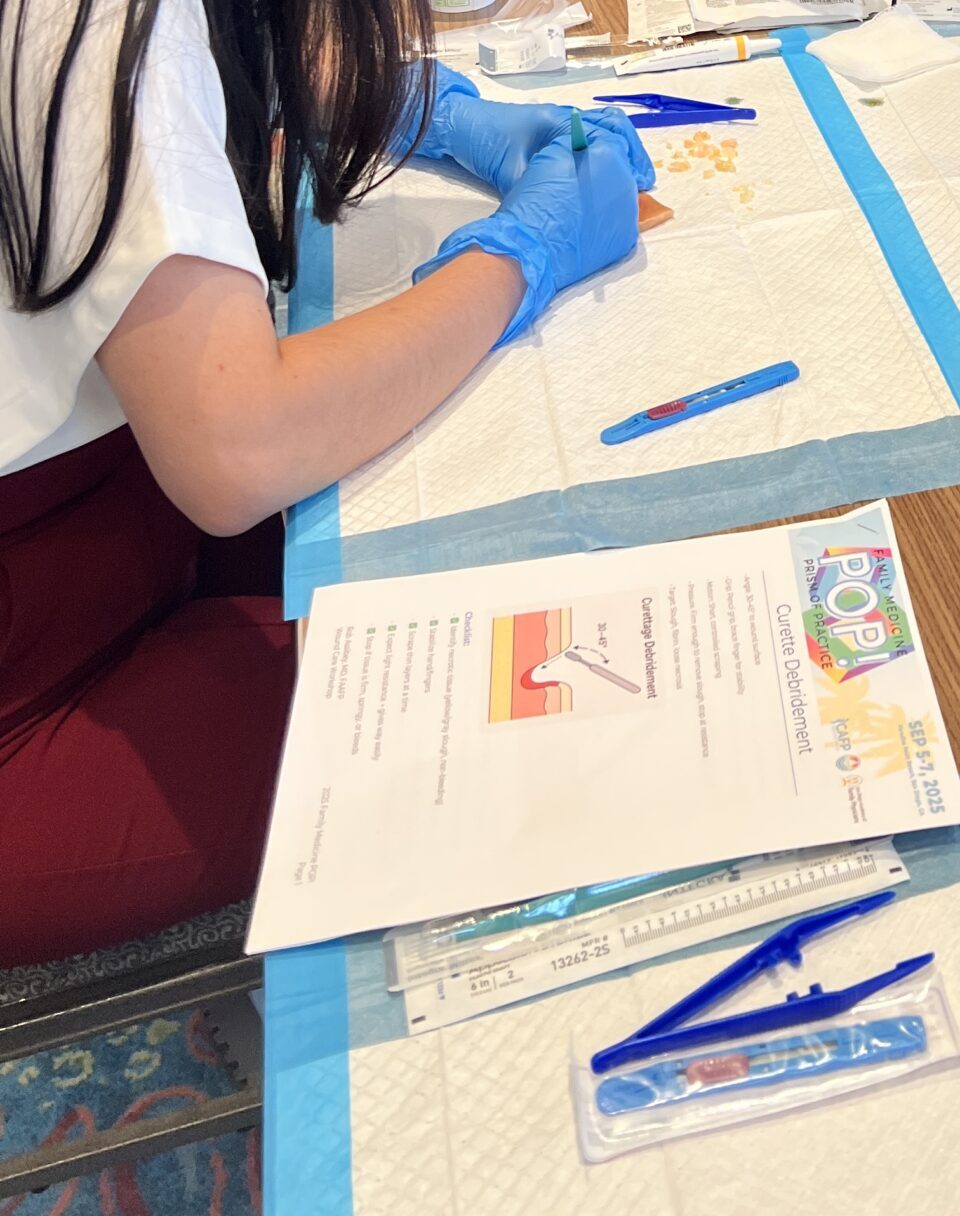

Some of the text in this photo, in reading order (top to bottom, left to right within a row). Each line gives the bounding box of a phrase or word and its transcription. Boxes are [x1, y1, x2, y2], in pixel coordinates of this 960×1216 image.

[726, 592, 735, 610] Pencil
[817, 551, 890, 668] POP!
[872, 549, 908, 657] FAMILY MEDICINE
[802, 558, 833, 669] PRISM OF PRACTICE
[405, 630, 416, 651] Scrape
[427, 627, 437, 652] Stabilize
[447, 625, 458, 648] Identify
[461, 611, 473, 647] Checklist:
[689, 624, 699, 649] enough
[709, 620, 720, 651] controlled
[748, 621, 759, 642] wound
[364, 635, 374, 650] Stop
[384, 632, 395, 654] Expect
[639, 596, 658, 699] Curettage Debridement
[730, 642, 741, 661] finger
[751, 642, 762, 666] surface
[324, 627, 344, 699] Wound Care Workshop
[362, 655, 371, 674] tissue
[382, 653, 392, 669] light
[405, 651, 414, 664] thin
[446, 648, 456, 674] necrotic
[672, 647, 681, 663] loose
[711, 651, 722, 679] scraping
[732, 660, 742, 670] for
[402, 664, 412, 683] layers
[693, 656, 702, 680] remove
[774, 602, 816, 755] Curette Debridement
[379, 669, 390, 702] resistance
[444, 674, 454, 693] tissue
[734, 670, 745, 695] stability
[400, 696, 409, 713] time
[350, 731, 361, 755] bleeds
[699, 726, 710, 758] resistance
[834, 722, 851, 752] CAFP
[907, 719, 945, 815] SEP 5-7, 2025
[315, 804, 328, 829] Family
[309, 829, 324, 864] Medicine
[293, 861, 307, 881] Page
[581, 937, 602, 949] MFR
[470, 978, 490, 991] 6 in
[507, 970, 515, 979] 2
